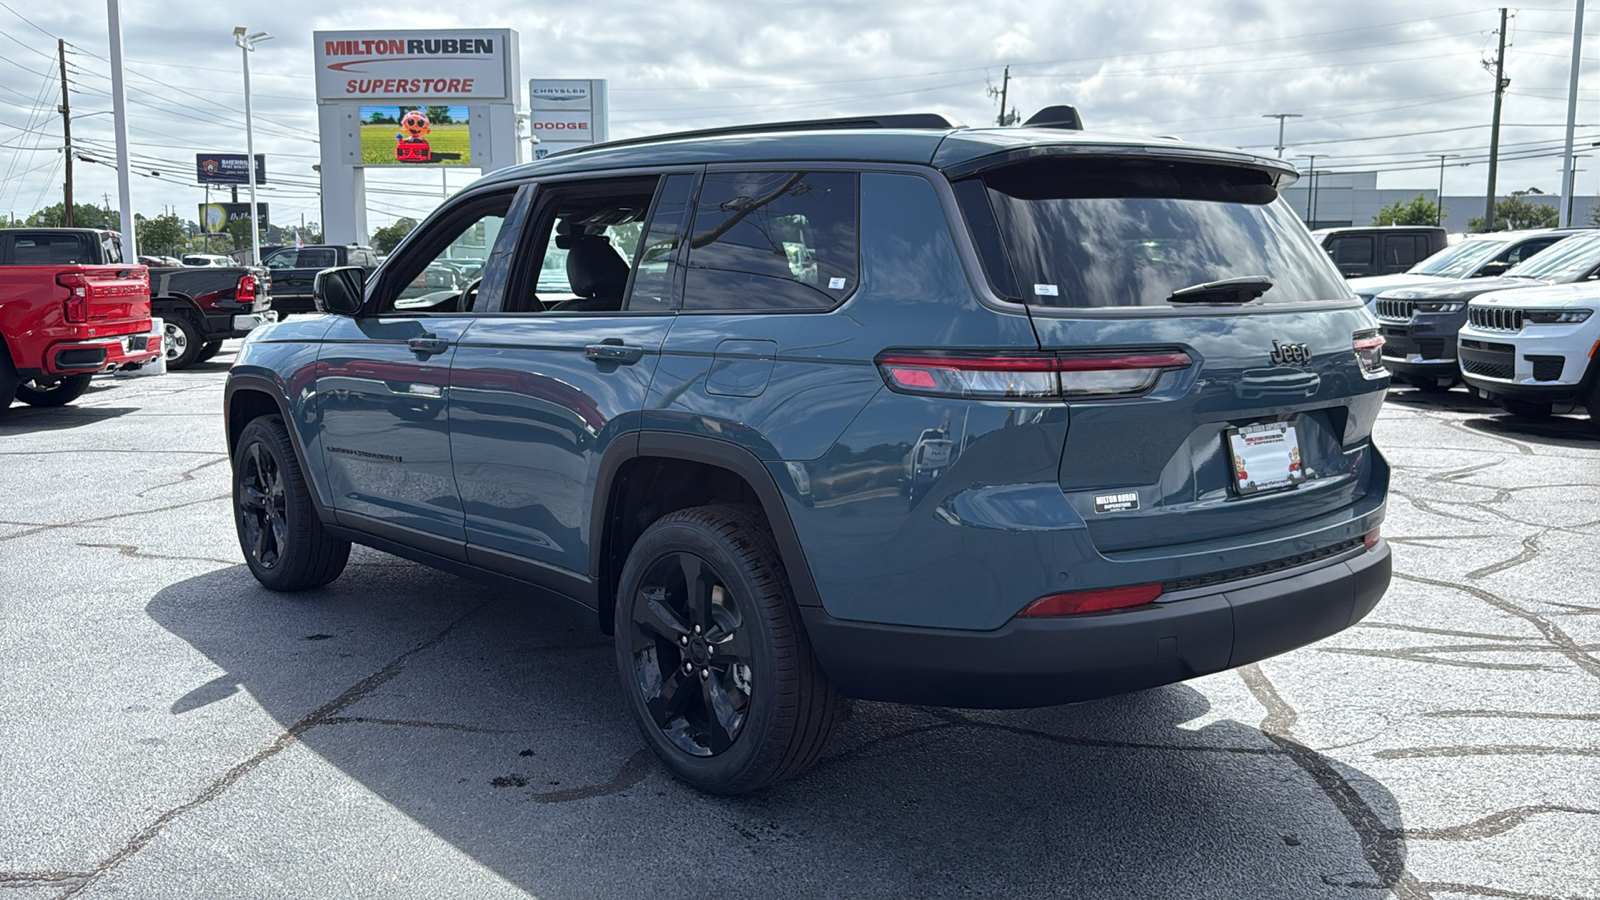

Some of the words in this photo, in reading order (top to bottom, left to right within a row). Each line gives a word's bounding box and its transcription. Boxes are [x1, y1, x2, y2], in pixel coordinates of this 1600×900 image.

[325, 39, 404, 56] MILTON
[407, 39, 493, 55] RUBEN
[345, 78, 475, 94] SUPERSTORE
[533, 122, 589, 130] DODGE
[1270, 339, 1312, 367] Jeep
[1096, 494, 1117, 505] MILTON
